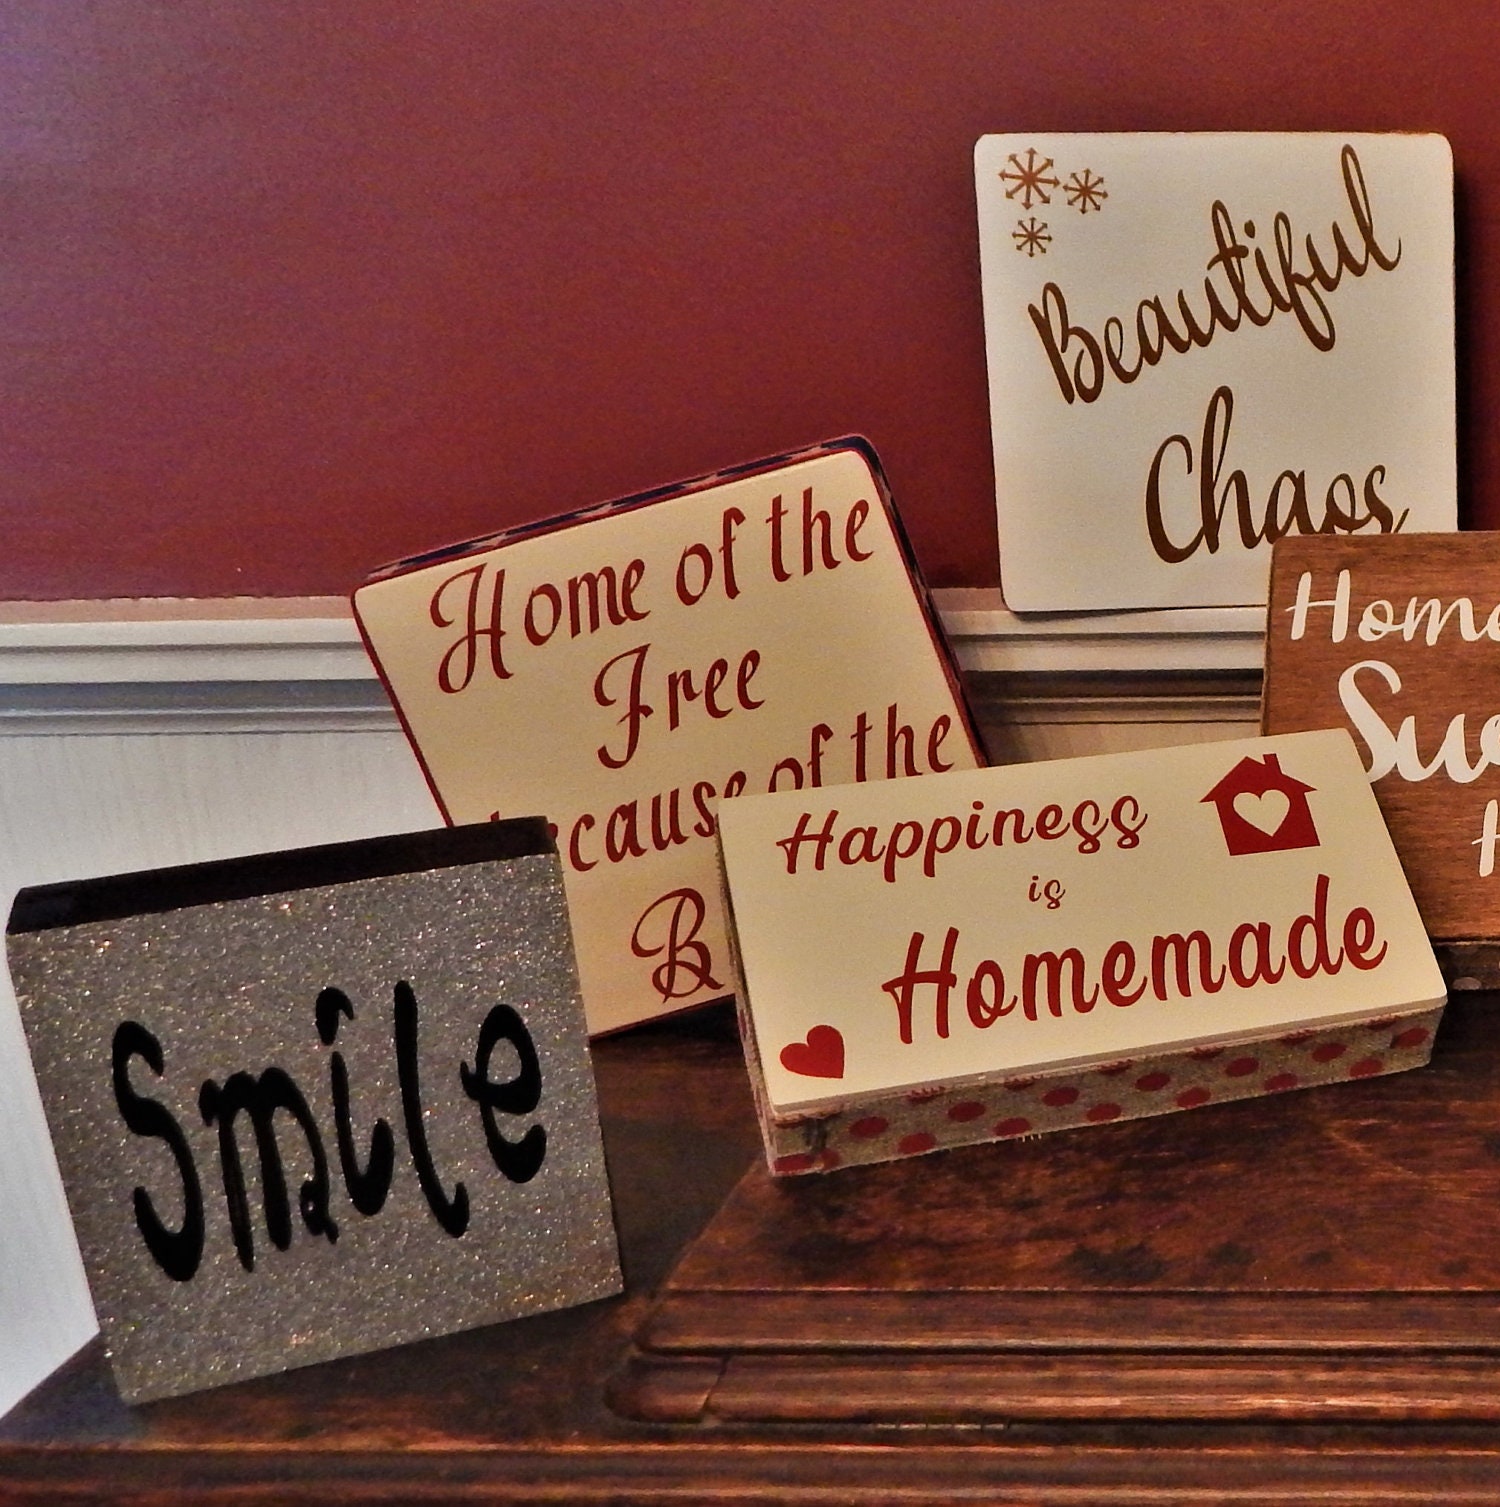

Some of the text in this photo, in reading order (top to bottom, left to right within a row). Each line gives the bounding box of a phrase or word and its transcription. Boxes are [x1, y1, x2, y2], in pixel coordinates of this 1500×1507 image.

[1027, 143, 1402, 405] Beautiful
[1145, 385, 1411, 565] Chaos
[429, 486, 877, 694] Home of the
[593, 643, 767, 769] Free
[769, 722, 834, 796] of
[852, 702, 957, 786] the
[775, 794, 1149, 884] Happiness
[1028, 873, 1067, 911] is
[882, 874, 1389, 1046] Homemade
[112, 980, 547, 1282] Smile
